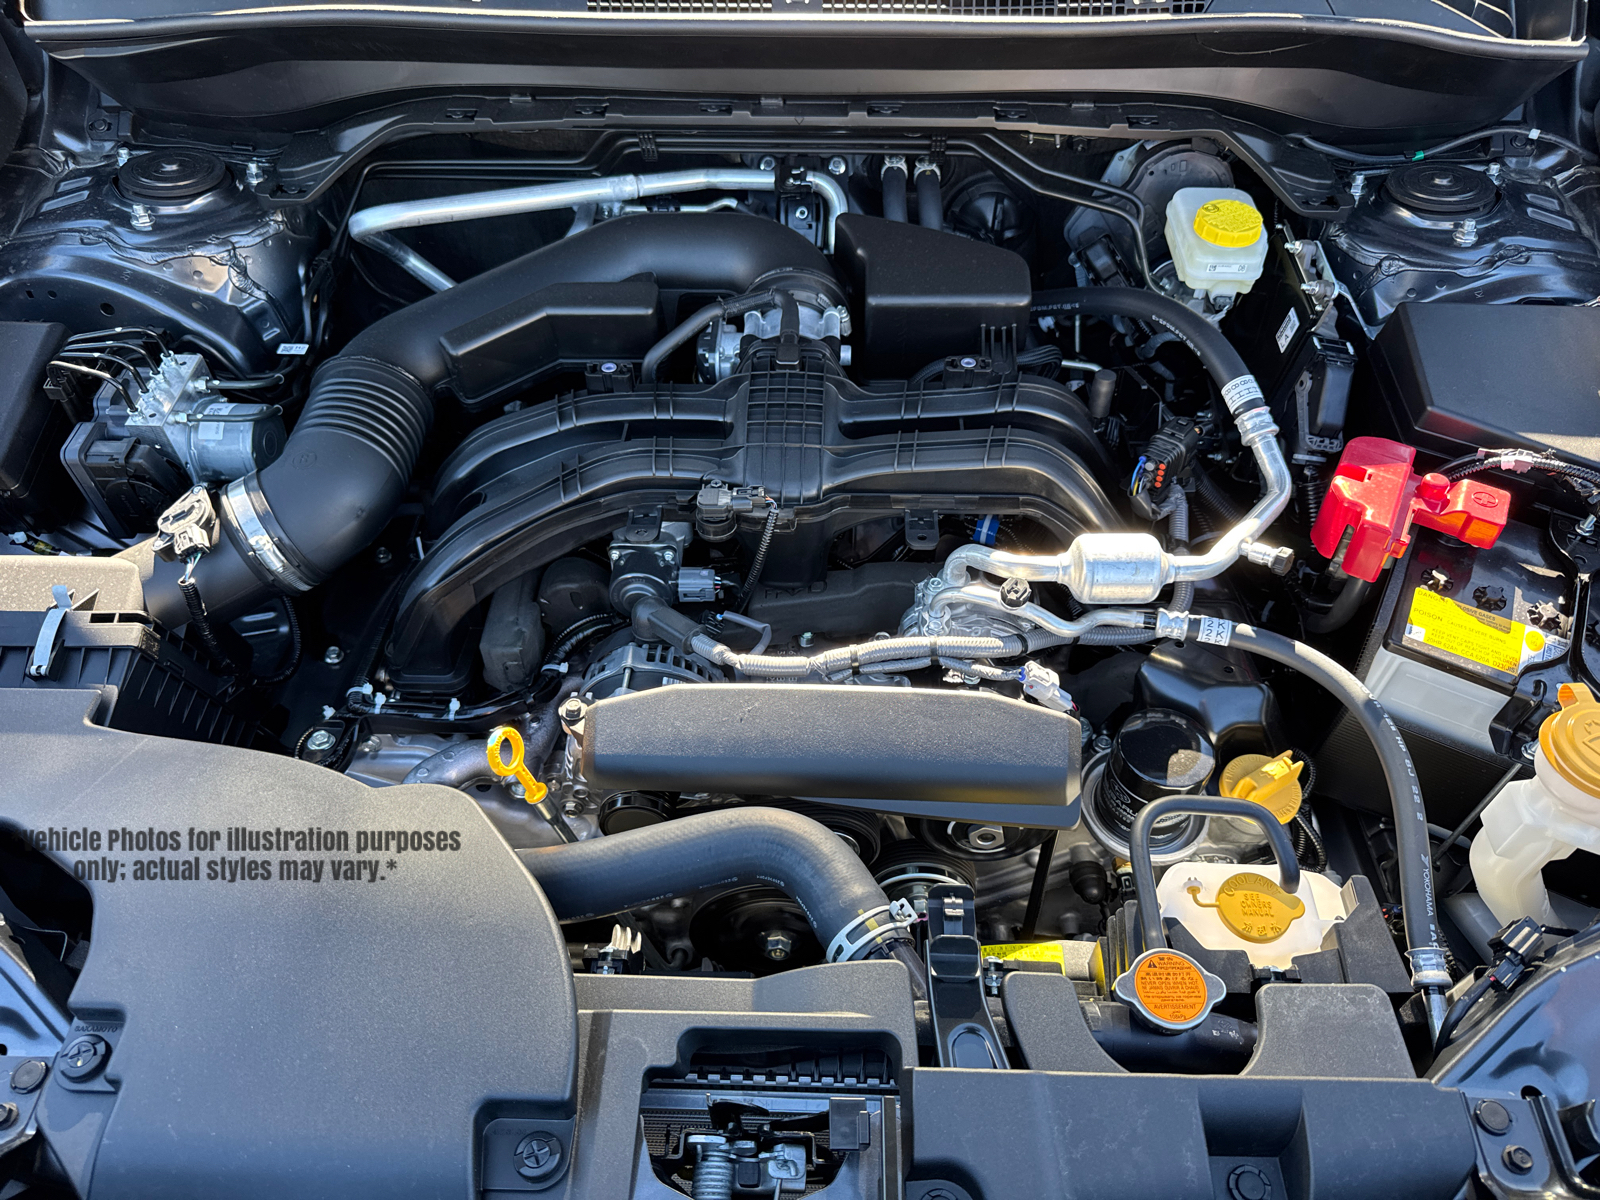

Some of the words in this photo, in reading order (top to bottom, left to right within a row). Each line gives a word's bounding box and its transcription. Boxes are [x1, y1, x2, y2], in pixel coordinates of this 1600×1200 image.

[1413, 607, 1443, 622] POISON
[1447, 620, 1467, 630] CAUSES
[1468, 627, 1487, 637] SEVERE
[1489, 634, 1506, 645] BURNS
[1461, 649, 1474, 658] CCA
[1223, 875, 1281, 896] COOLANT
[1423, 868, 1434, 916] YOKOHAMA
[1242, 908, 1274, 917] MANUAL
